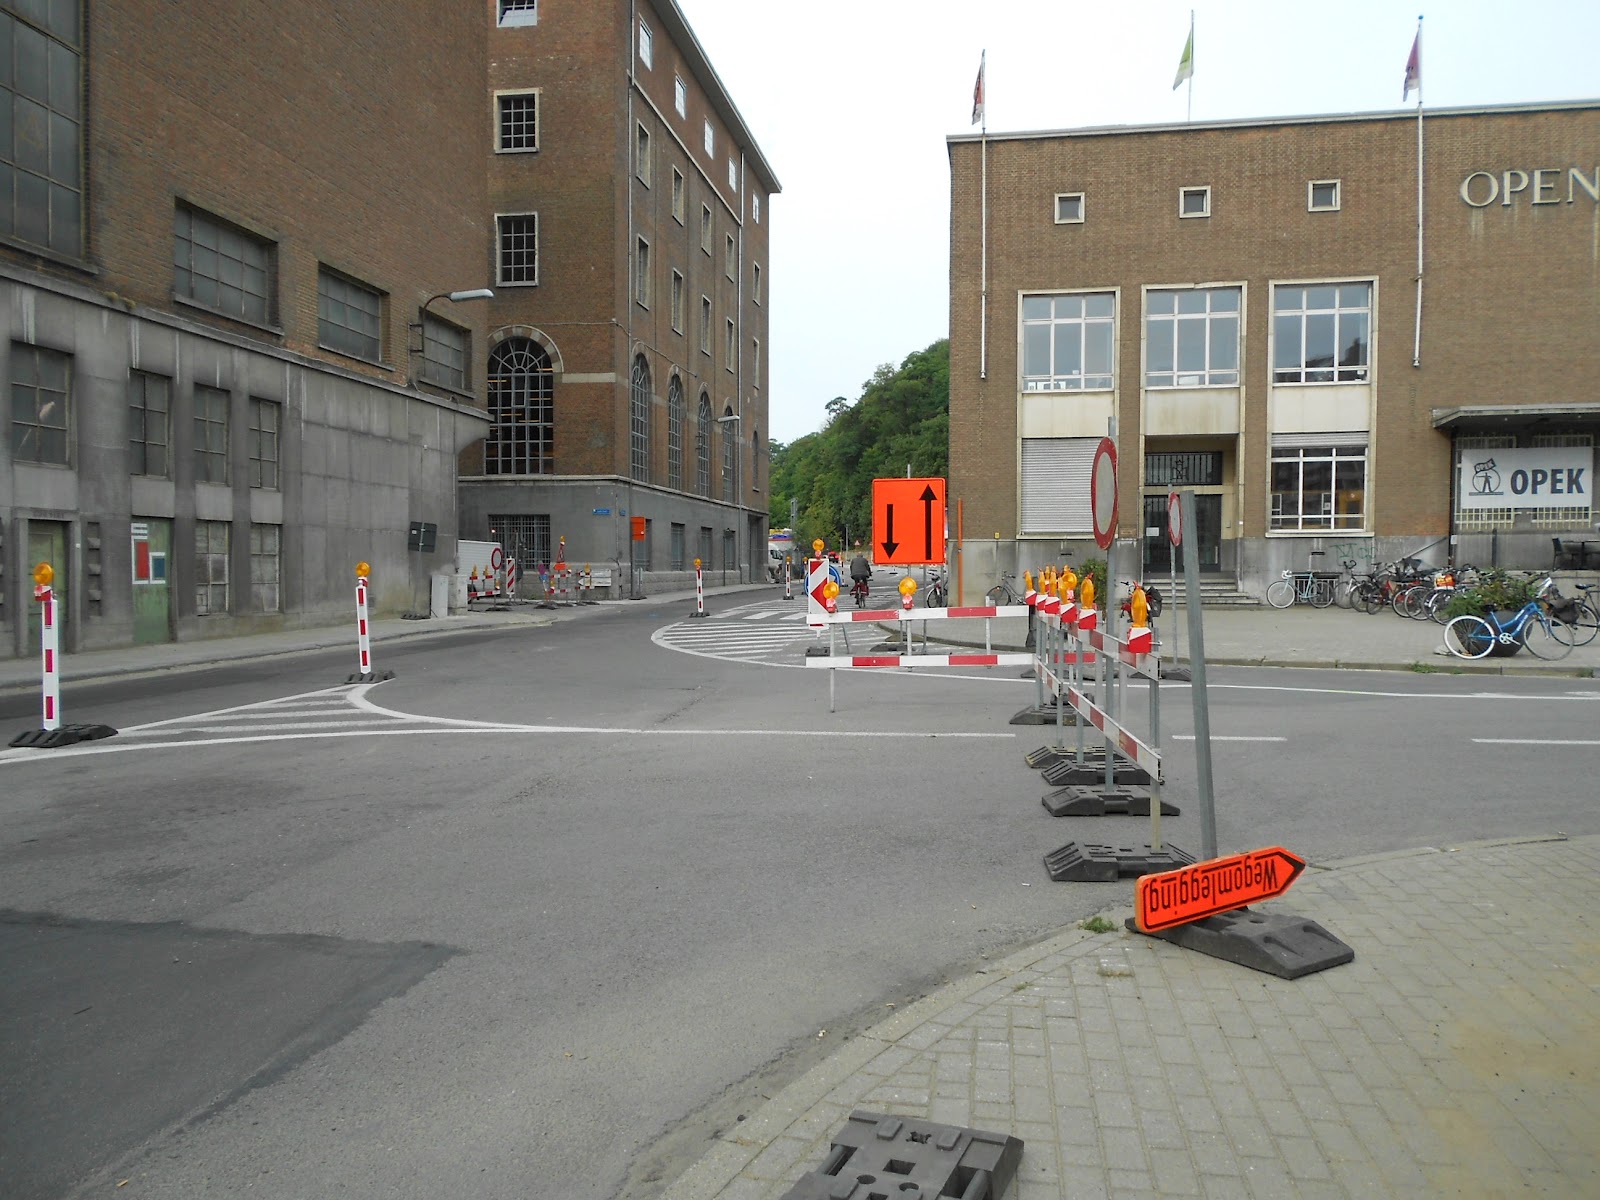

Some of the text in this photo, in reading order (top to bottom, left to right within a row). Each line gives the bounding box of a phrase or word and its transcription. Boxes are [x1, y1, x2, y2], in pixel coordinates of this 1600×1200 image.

[1459, 166, 1600, 207] OPEN
[1475, 459, 1495, 472] OPEK
[1510, 468, 1585, 495] OPEK
[1149, 855, 1278, 915] Wegomlegging
